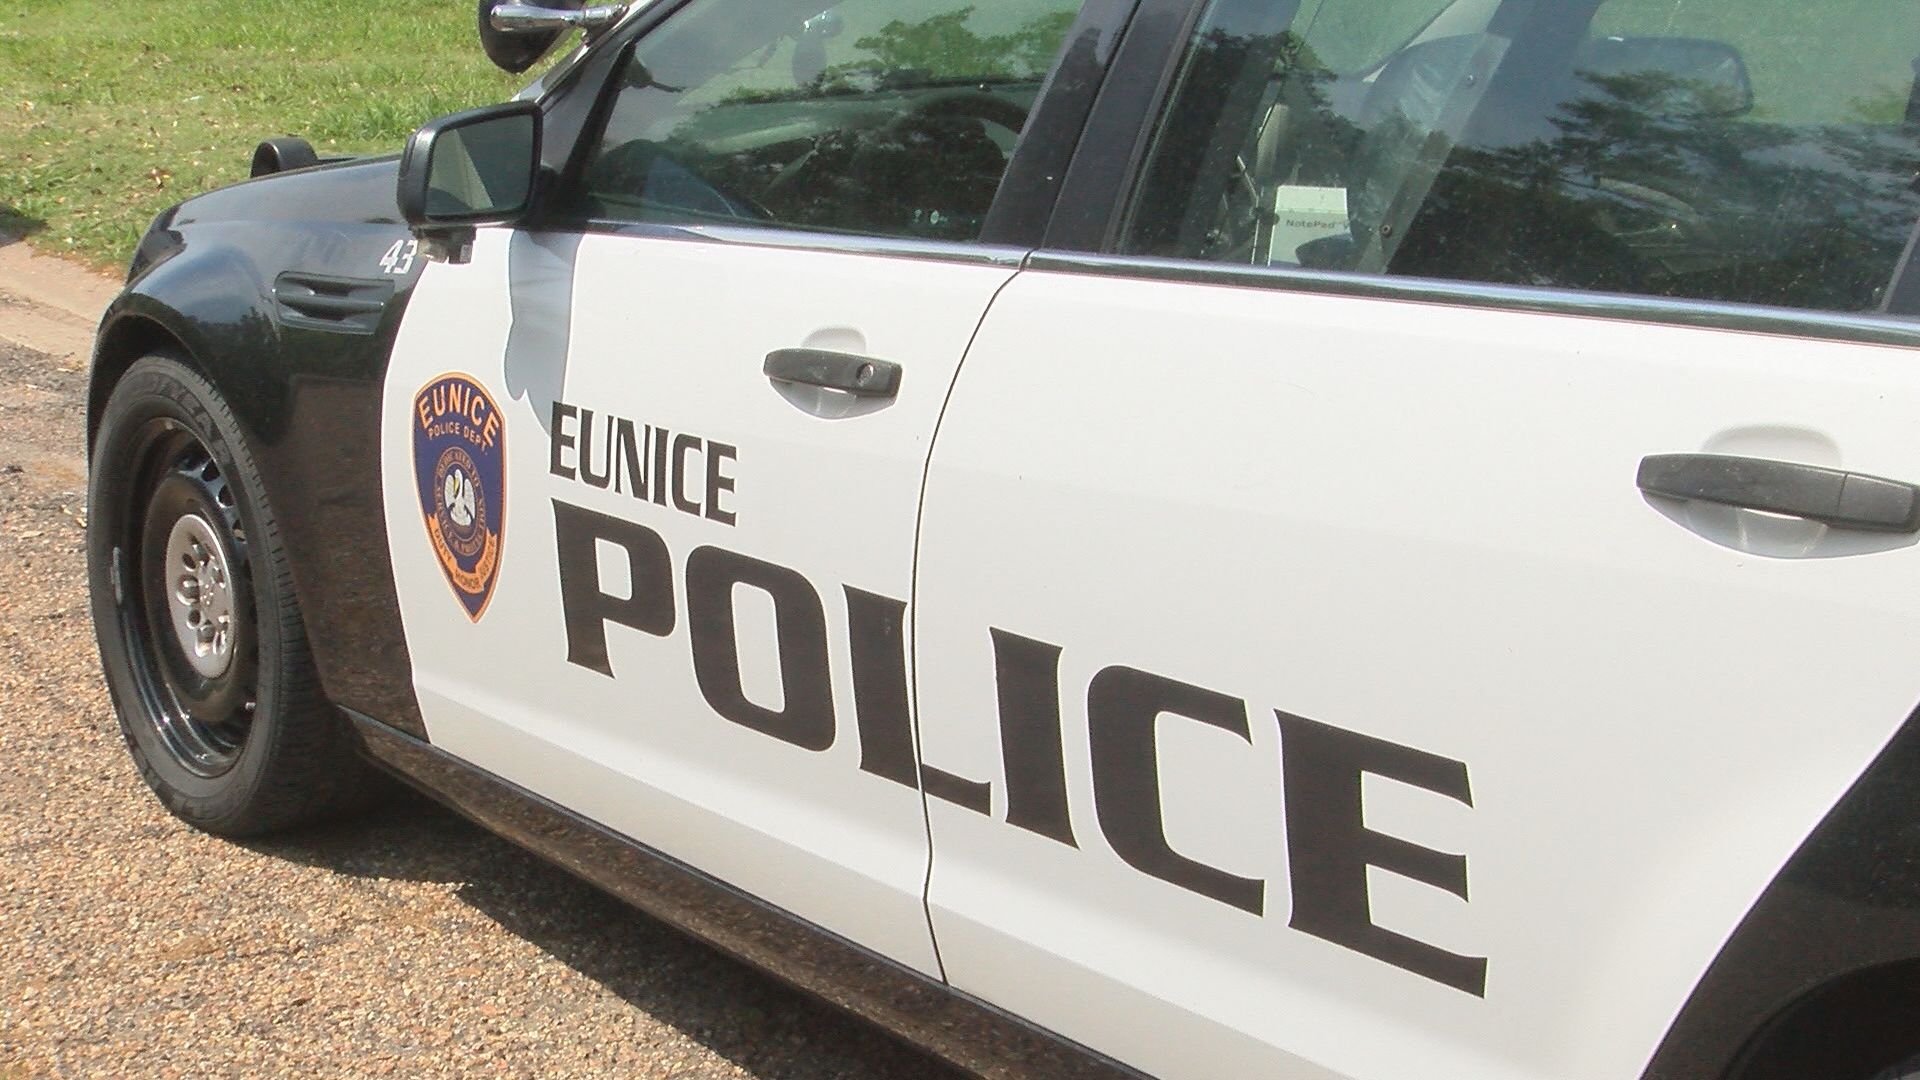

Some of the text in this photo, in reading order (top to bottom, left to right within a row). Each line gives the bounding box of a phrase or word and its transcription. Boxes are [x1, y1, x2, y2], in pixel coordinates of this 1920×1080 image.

[1286, 219, 1335, 229] NotePad
[379, 239, 418, 275] 43
[418, 383, 500, 448] EUNICE
[428, 421, 461, 441] POLICE
[549, 400, 737, 527] EUNICE
[551, 497, 1487, 999] POLICE
